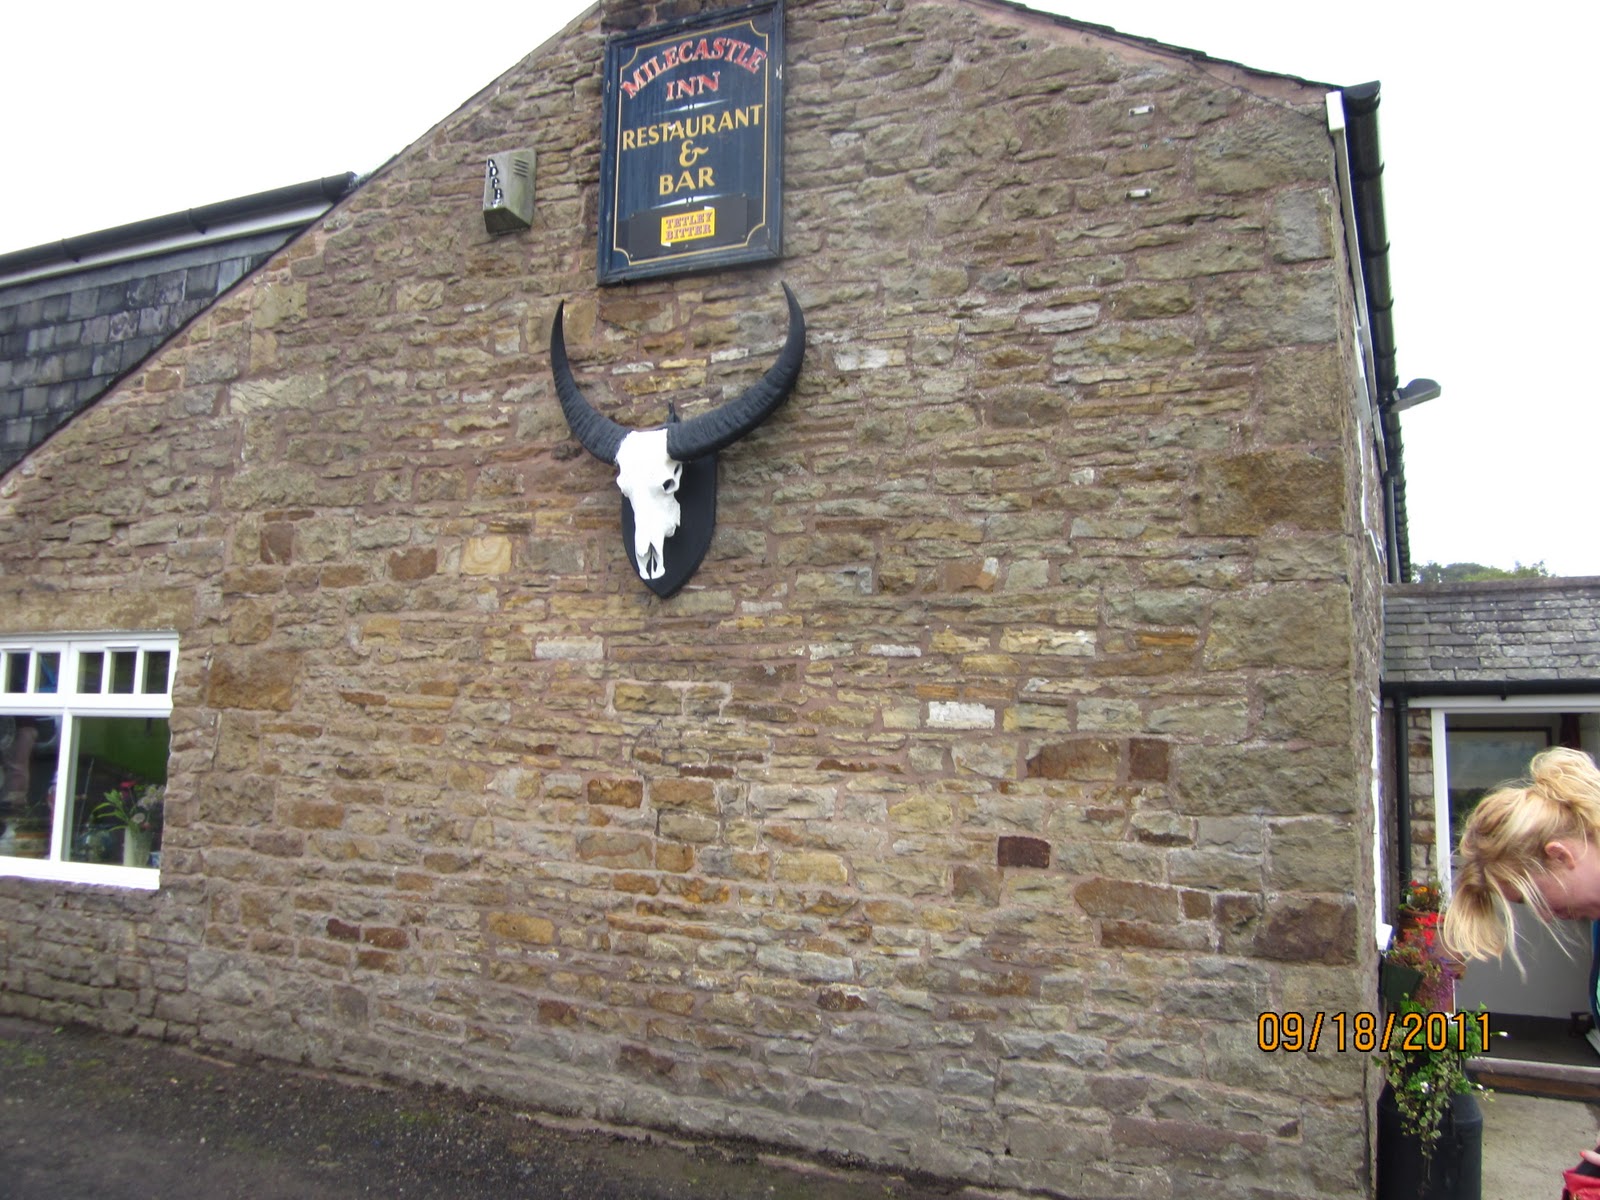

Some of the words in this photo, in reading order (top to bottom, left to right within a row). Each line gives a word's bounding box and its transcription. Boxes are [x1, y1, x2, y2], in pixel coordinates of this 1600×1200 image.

[620, 37, 767, 99] MILECASTLE
[665, 71, 721, 101] INN
[622, 104, 763, 151] RESTAURANT
[679, 139, 709, 168] &
[659, 166, 715, 196] BAR
[665, 211, 713, 230] TETLEY
[665, 223, 711, 241] BITTER
